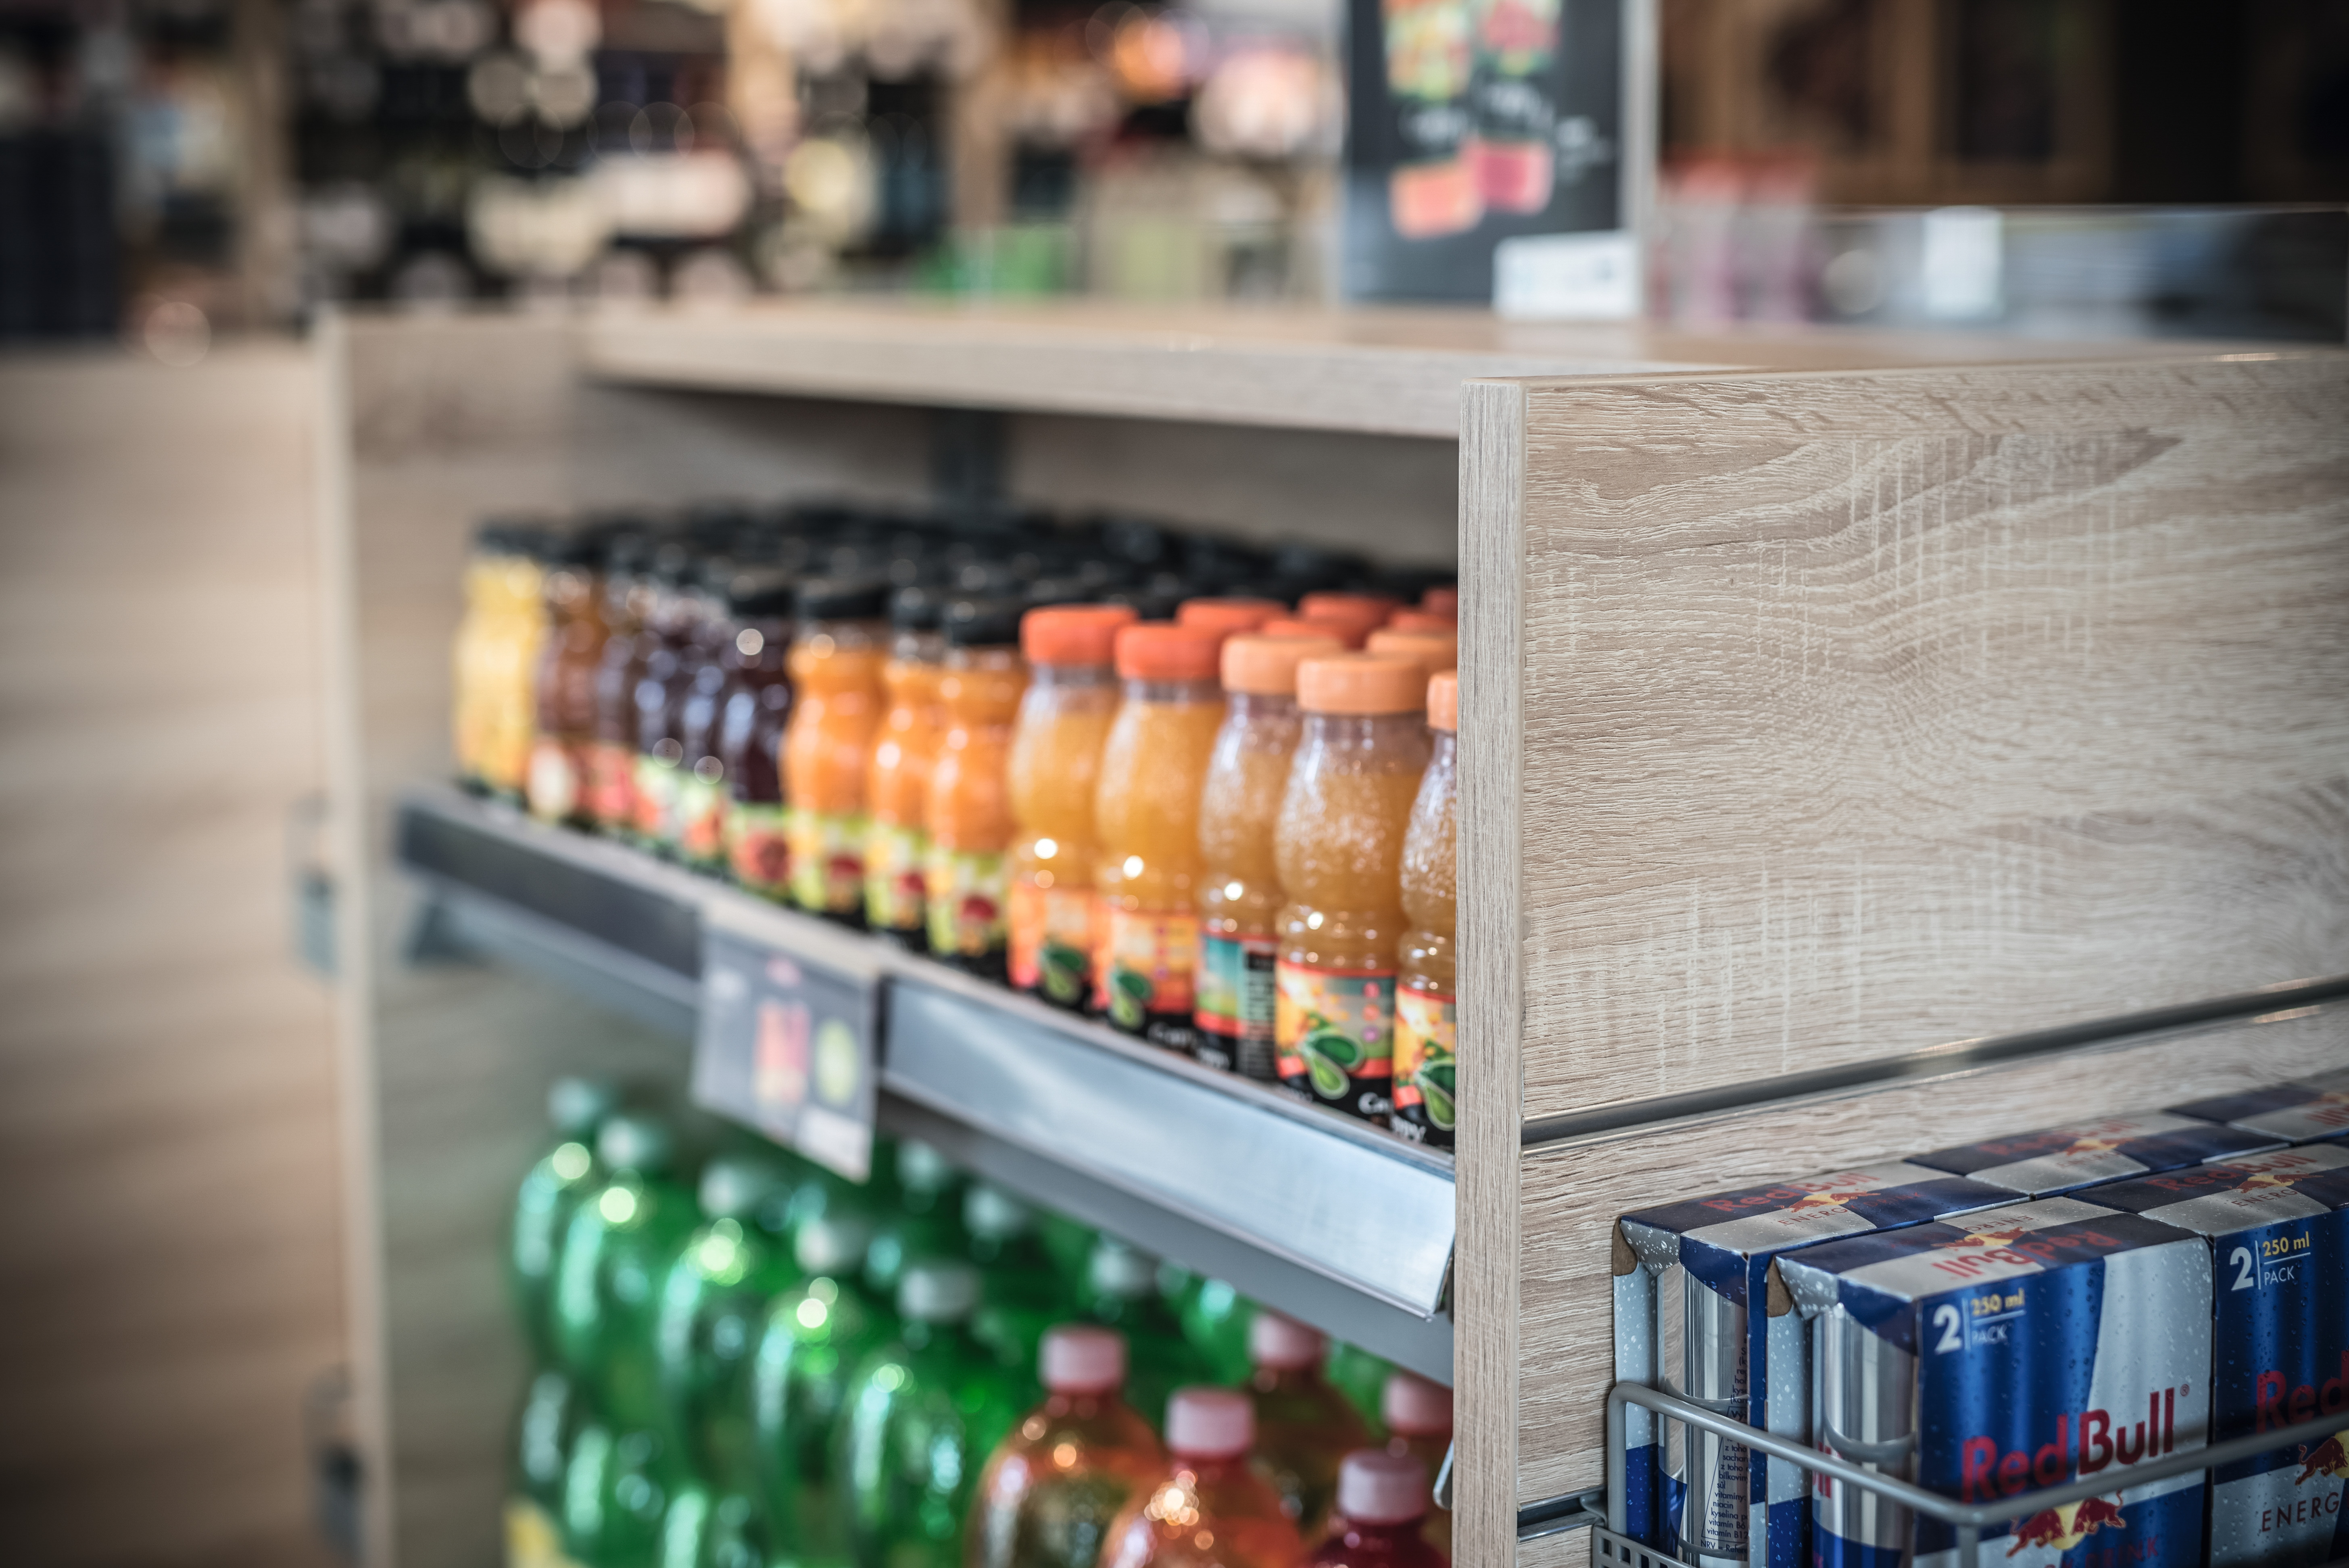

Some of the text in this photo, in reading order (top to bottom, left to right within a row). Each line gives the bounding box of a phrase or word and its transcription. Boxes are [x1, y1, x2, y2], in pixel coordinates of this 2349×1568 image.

[2144, 1153, 2318, 1191] Red Bull
[1699, 1172, 1881, 1211] Red Bull
[2232, 1189, 2298, 1207] ENERG
[1964, 1215, 2034, 1232] ENERG
[2263, 1230, 2310, 1257] 250 ml
[1931, 1230, 2122, 1278] Red Bull
[2230, 1246, 2254, 1291] 2
[2264, 1266, 2295, 1286] PACK
[1970, 1288, 2025, 1316] 250 ml
[1932, 1303, 1962, 1355] 2
[1971, 1324, 2008, 1345] PACK
[2256, 1350, 2349, 1434] Red
[1732, 1442, 1747, 1452] toho
[1962, 1387, 2175, 1504] Red Bull
[1727, 1462, 1743, 1472] toho
[1713, 1500, 1734, 1510] niacin
[1715, 1491, 1746, 1503] vitamíny:
[1711, 1507, 1738, 1519] kyselina
[2262, 1492, 2339, 1532] ENERG
[1707, 1527, 1732, 1538] vitamín
[1709, 1518, 1746, 1530] vitamín B6
[1701, 1539, 1716, 1550] NRV
